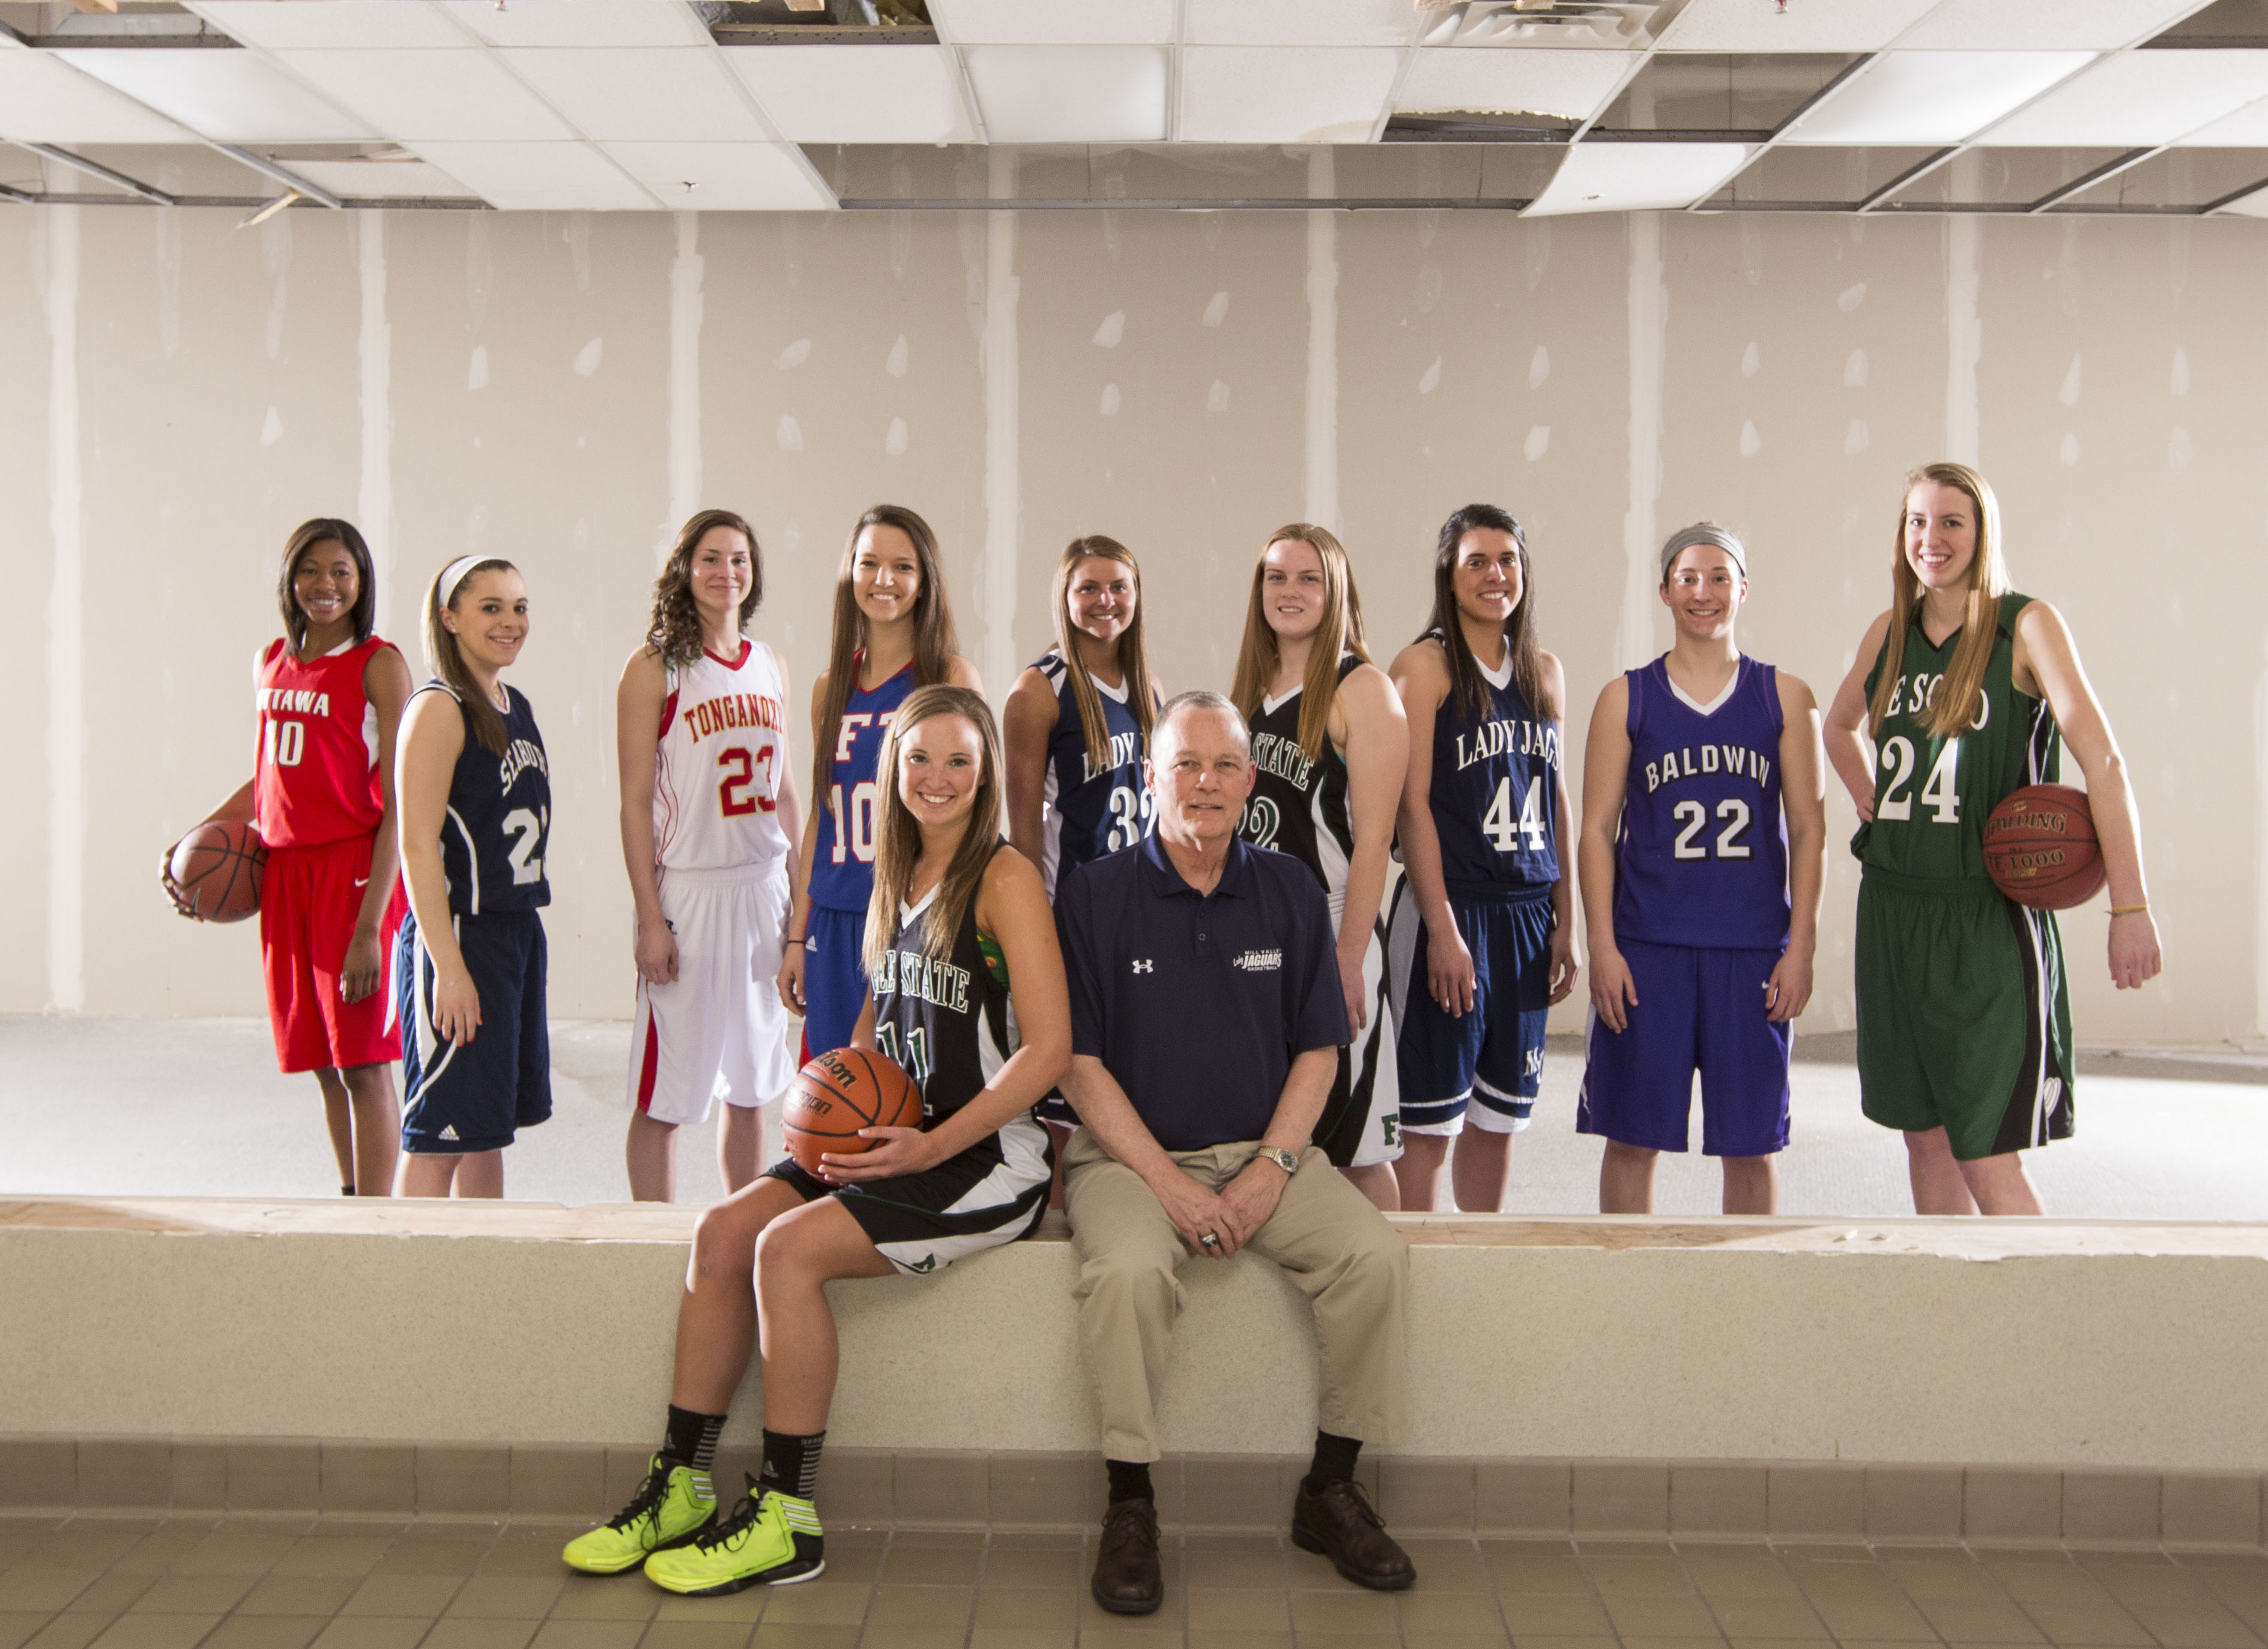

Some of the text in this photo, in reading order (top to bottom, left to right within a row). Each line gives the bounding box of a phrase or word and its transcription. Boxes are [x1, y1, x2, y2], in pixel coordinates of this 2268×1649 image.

[265, 719, 304, 766] 10
[1251, 732, 1315, 792] STATE
[1456, 720, 1559, 771] LADY JAGS
[1645, 745, 1770, 795] BALDWIN
[717, 745, 776, 819] 23
[1877, 736, 1960, 824] 24
[501, 804, 548, 886] 2
[831, 781, 877, 865] 10
[1236, 796, 1280, 852] 2
[1483, 776, 1546, 852] 44
[1674, 799, 1755, 861] 22
[901, 951, 970, 1014] STATE
[1241, 953, 1282, 969] JAGUARS
